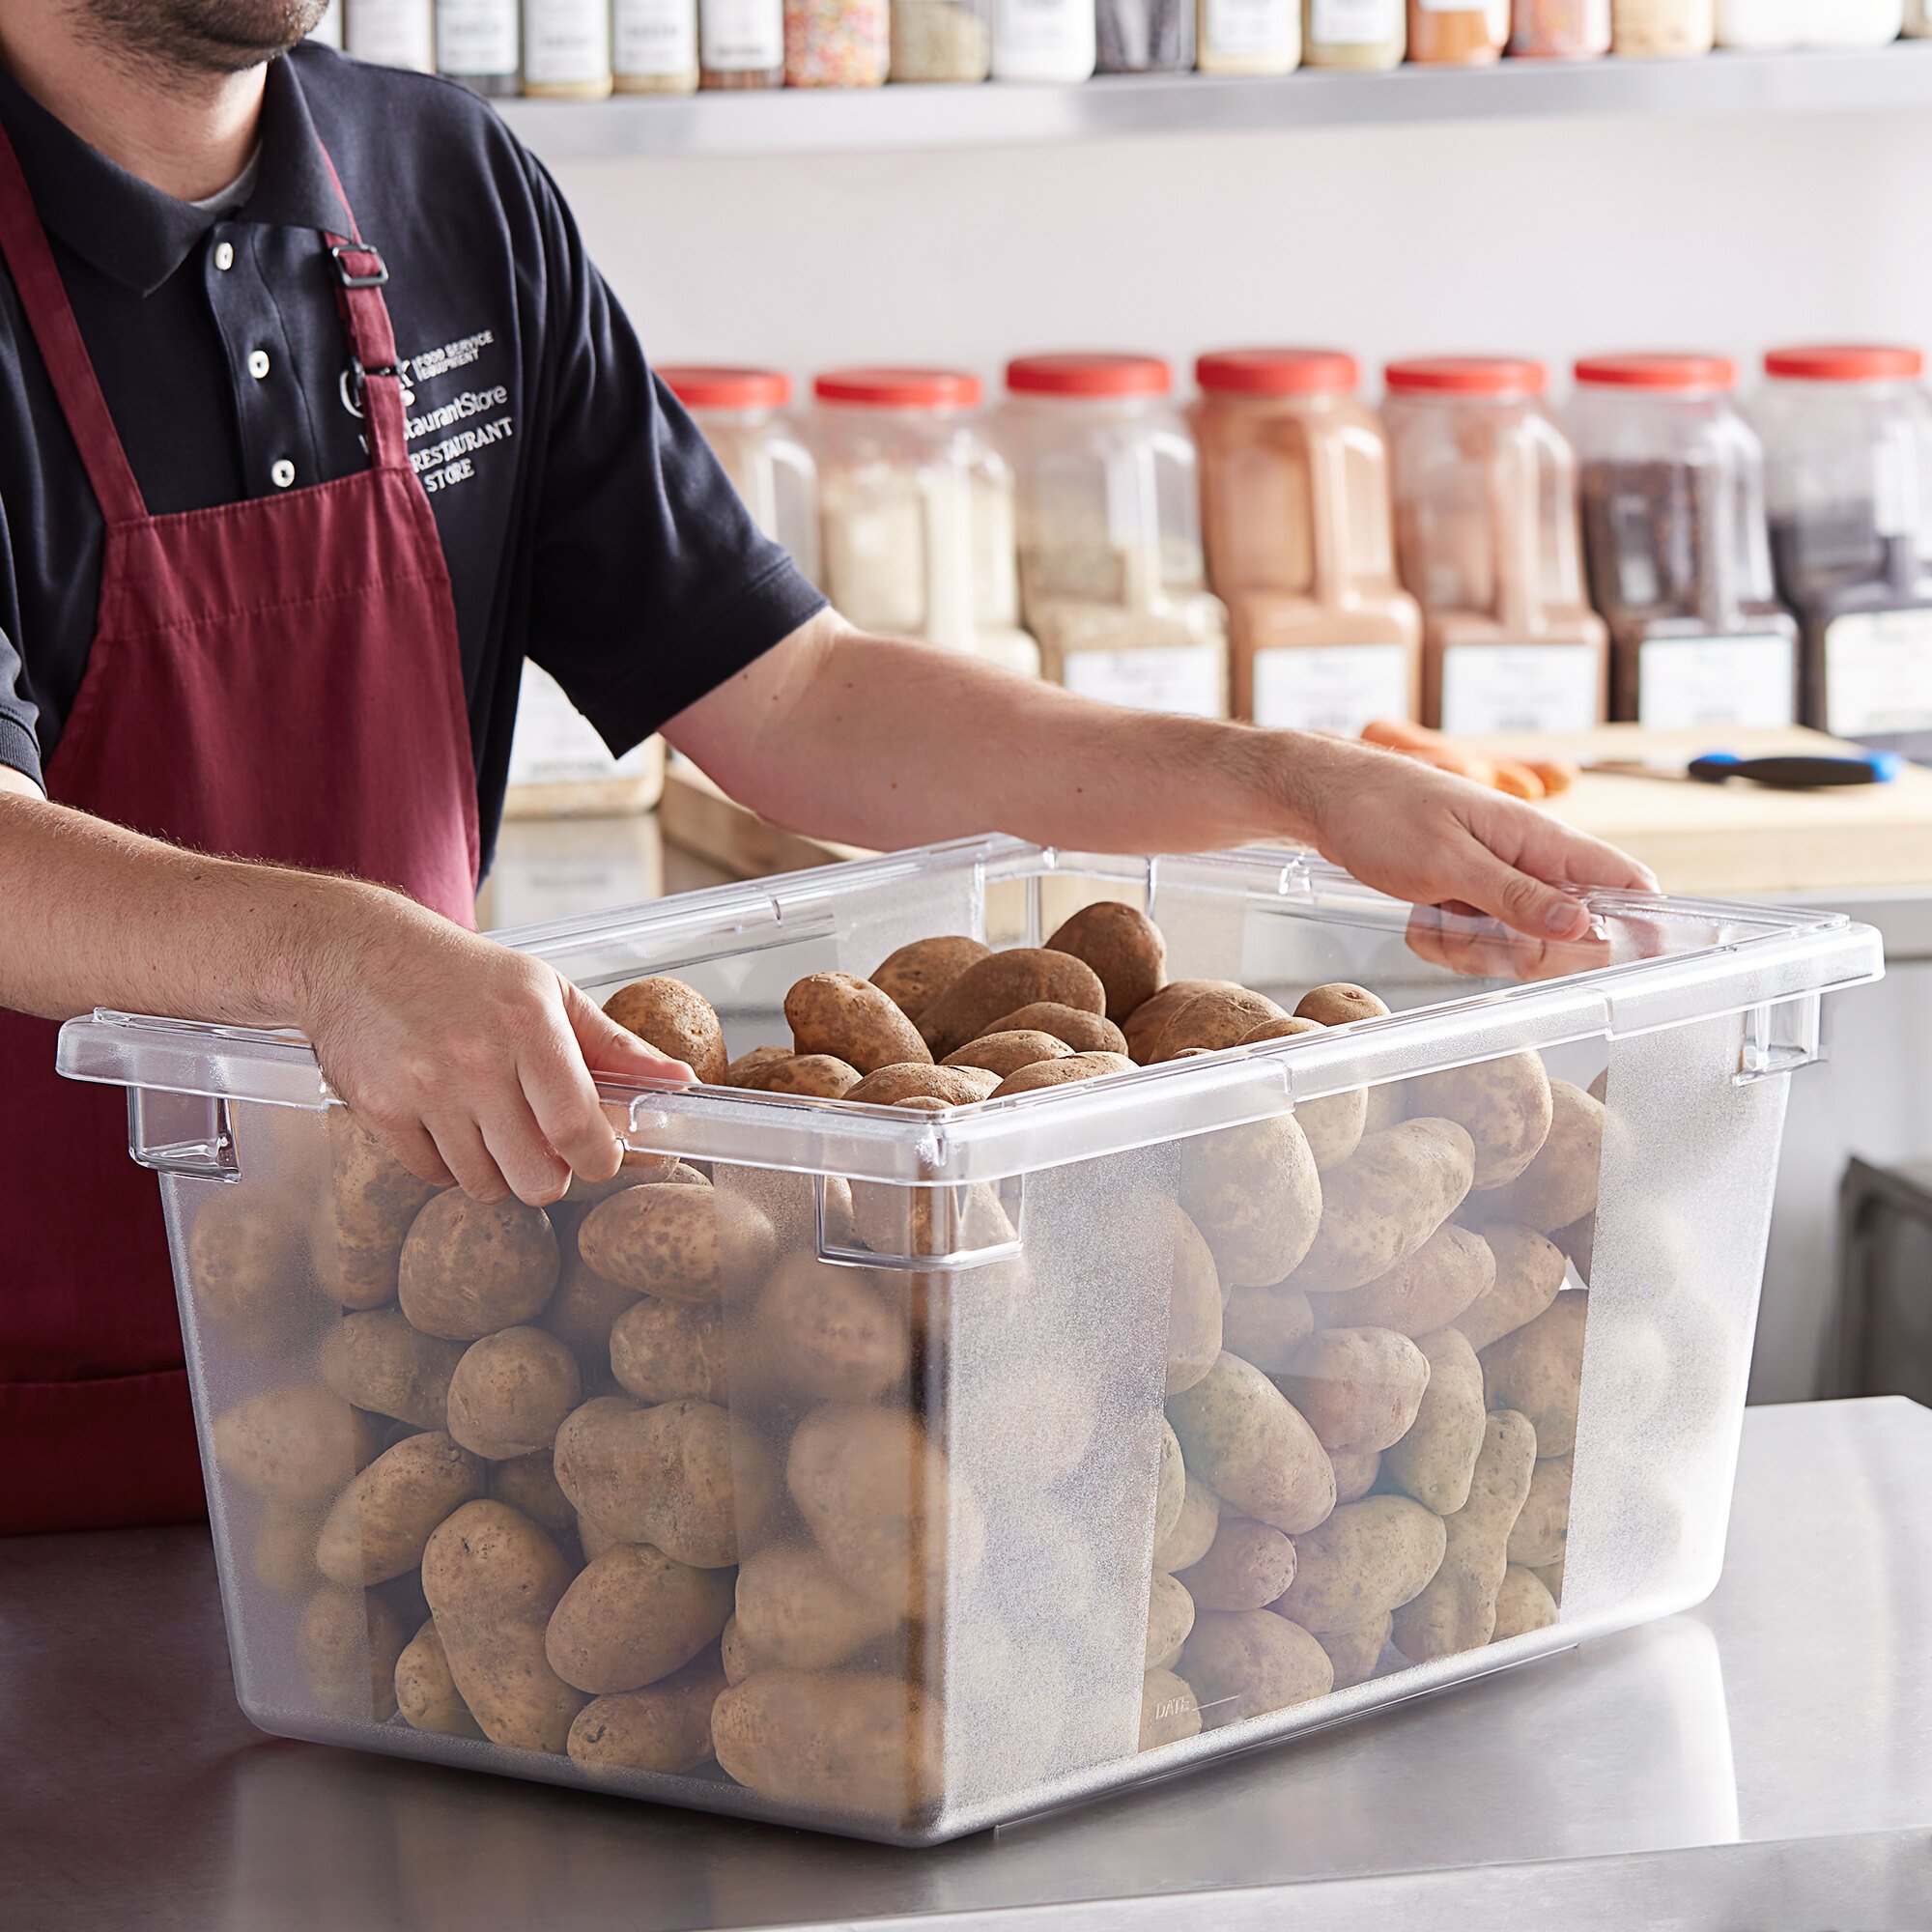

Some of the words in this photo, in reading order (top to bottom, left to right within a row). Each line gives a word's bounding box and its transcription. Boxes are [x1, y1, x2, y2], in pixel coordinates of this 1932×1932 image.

[416, 347, 445, 369] FOOD
[444, 329, 495, 358] SERVICE
[409, 416, 513, 473] RESTAURANT
[424, 458, 475, 493] STORE
[1155, 1695, 1190, 1719] DATE
